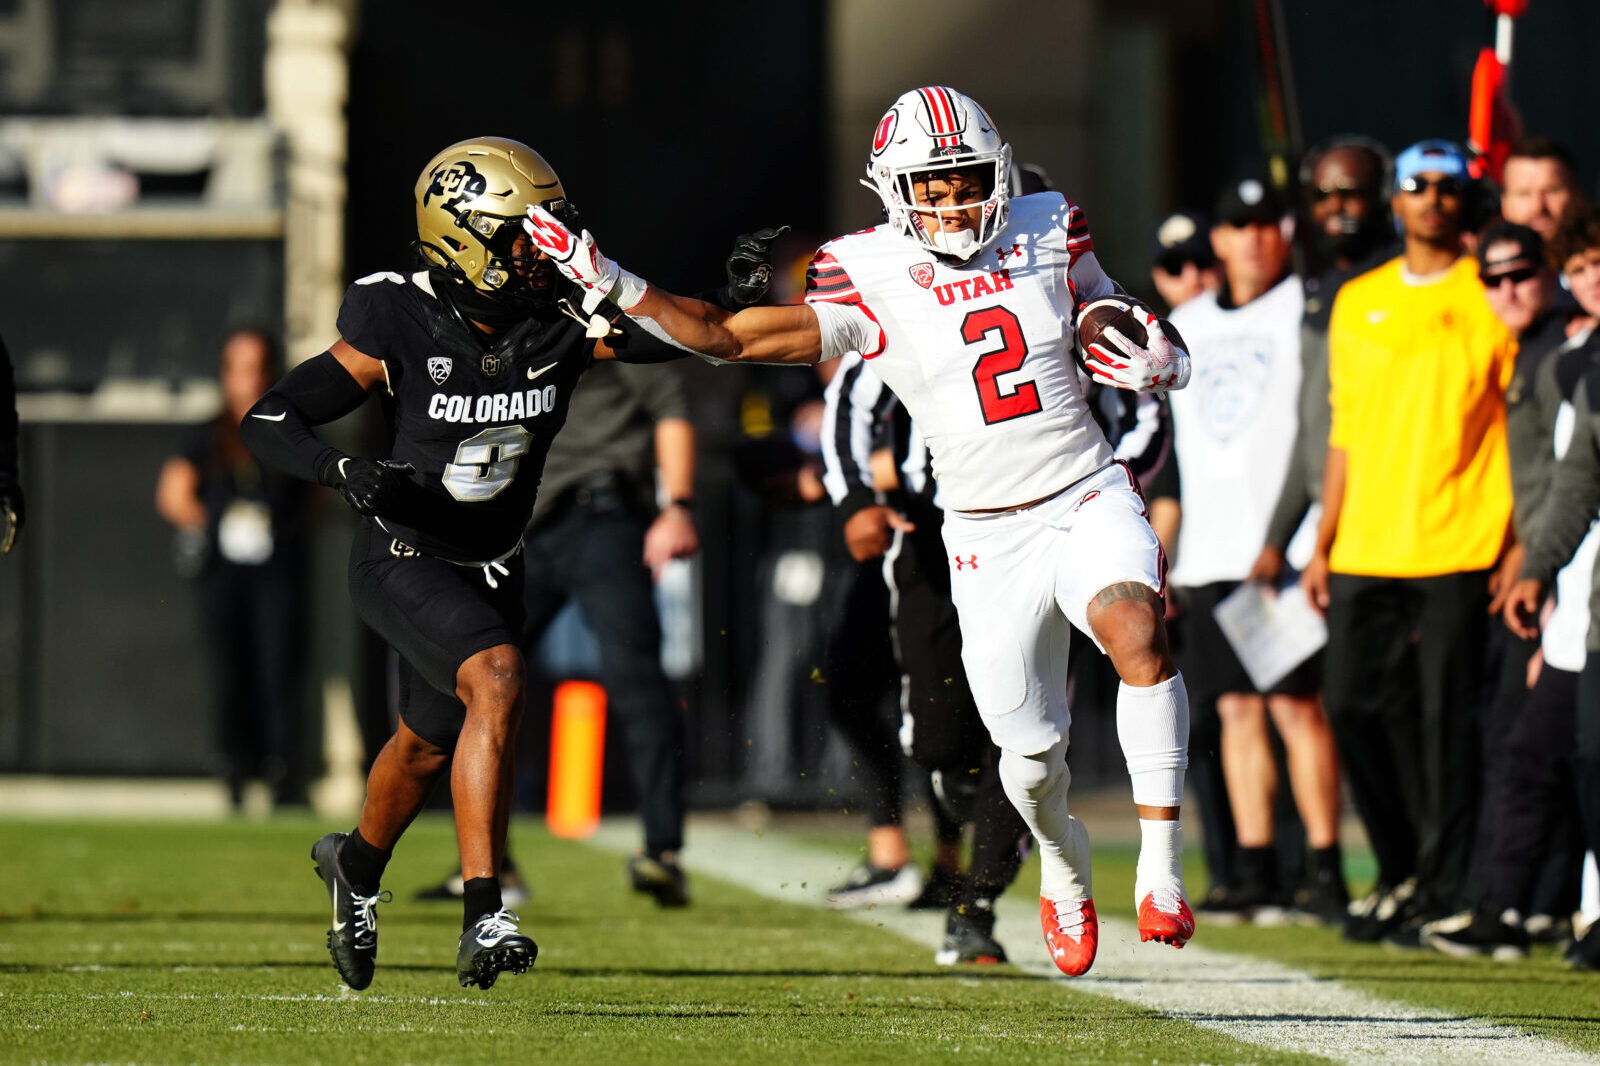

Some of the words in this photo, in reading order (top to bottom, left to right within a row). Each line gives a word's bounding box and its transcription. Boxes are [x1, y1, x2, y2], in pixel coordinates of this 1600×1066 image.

[933, 268, 1014, 306] UTAH
[960, 304, 1043, 426] 2
[427, 384, 557, 423] COLORADO
